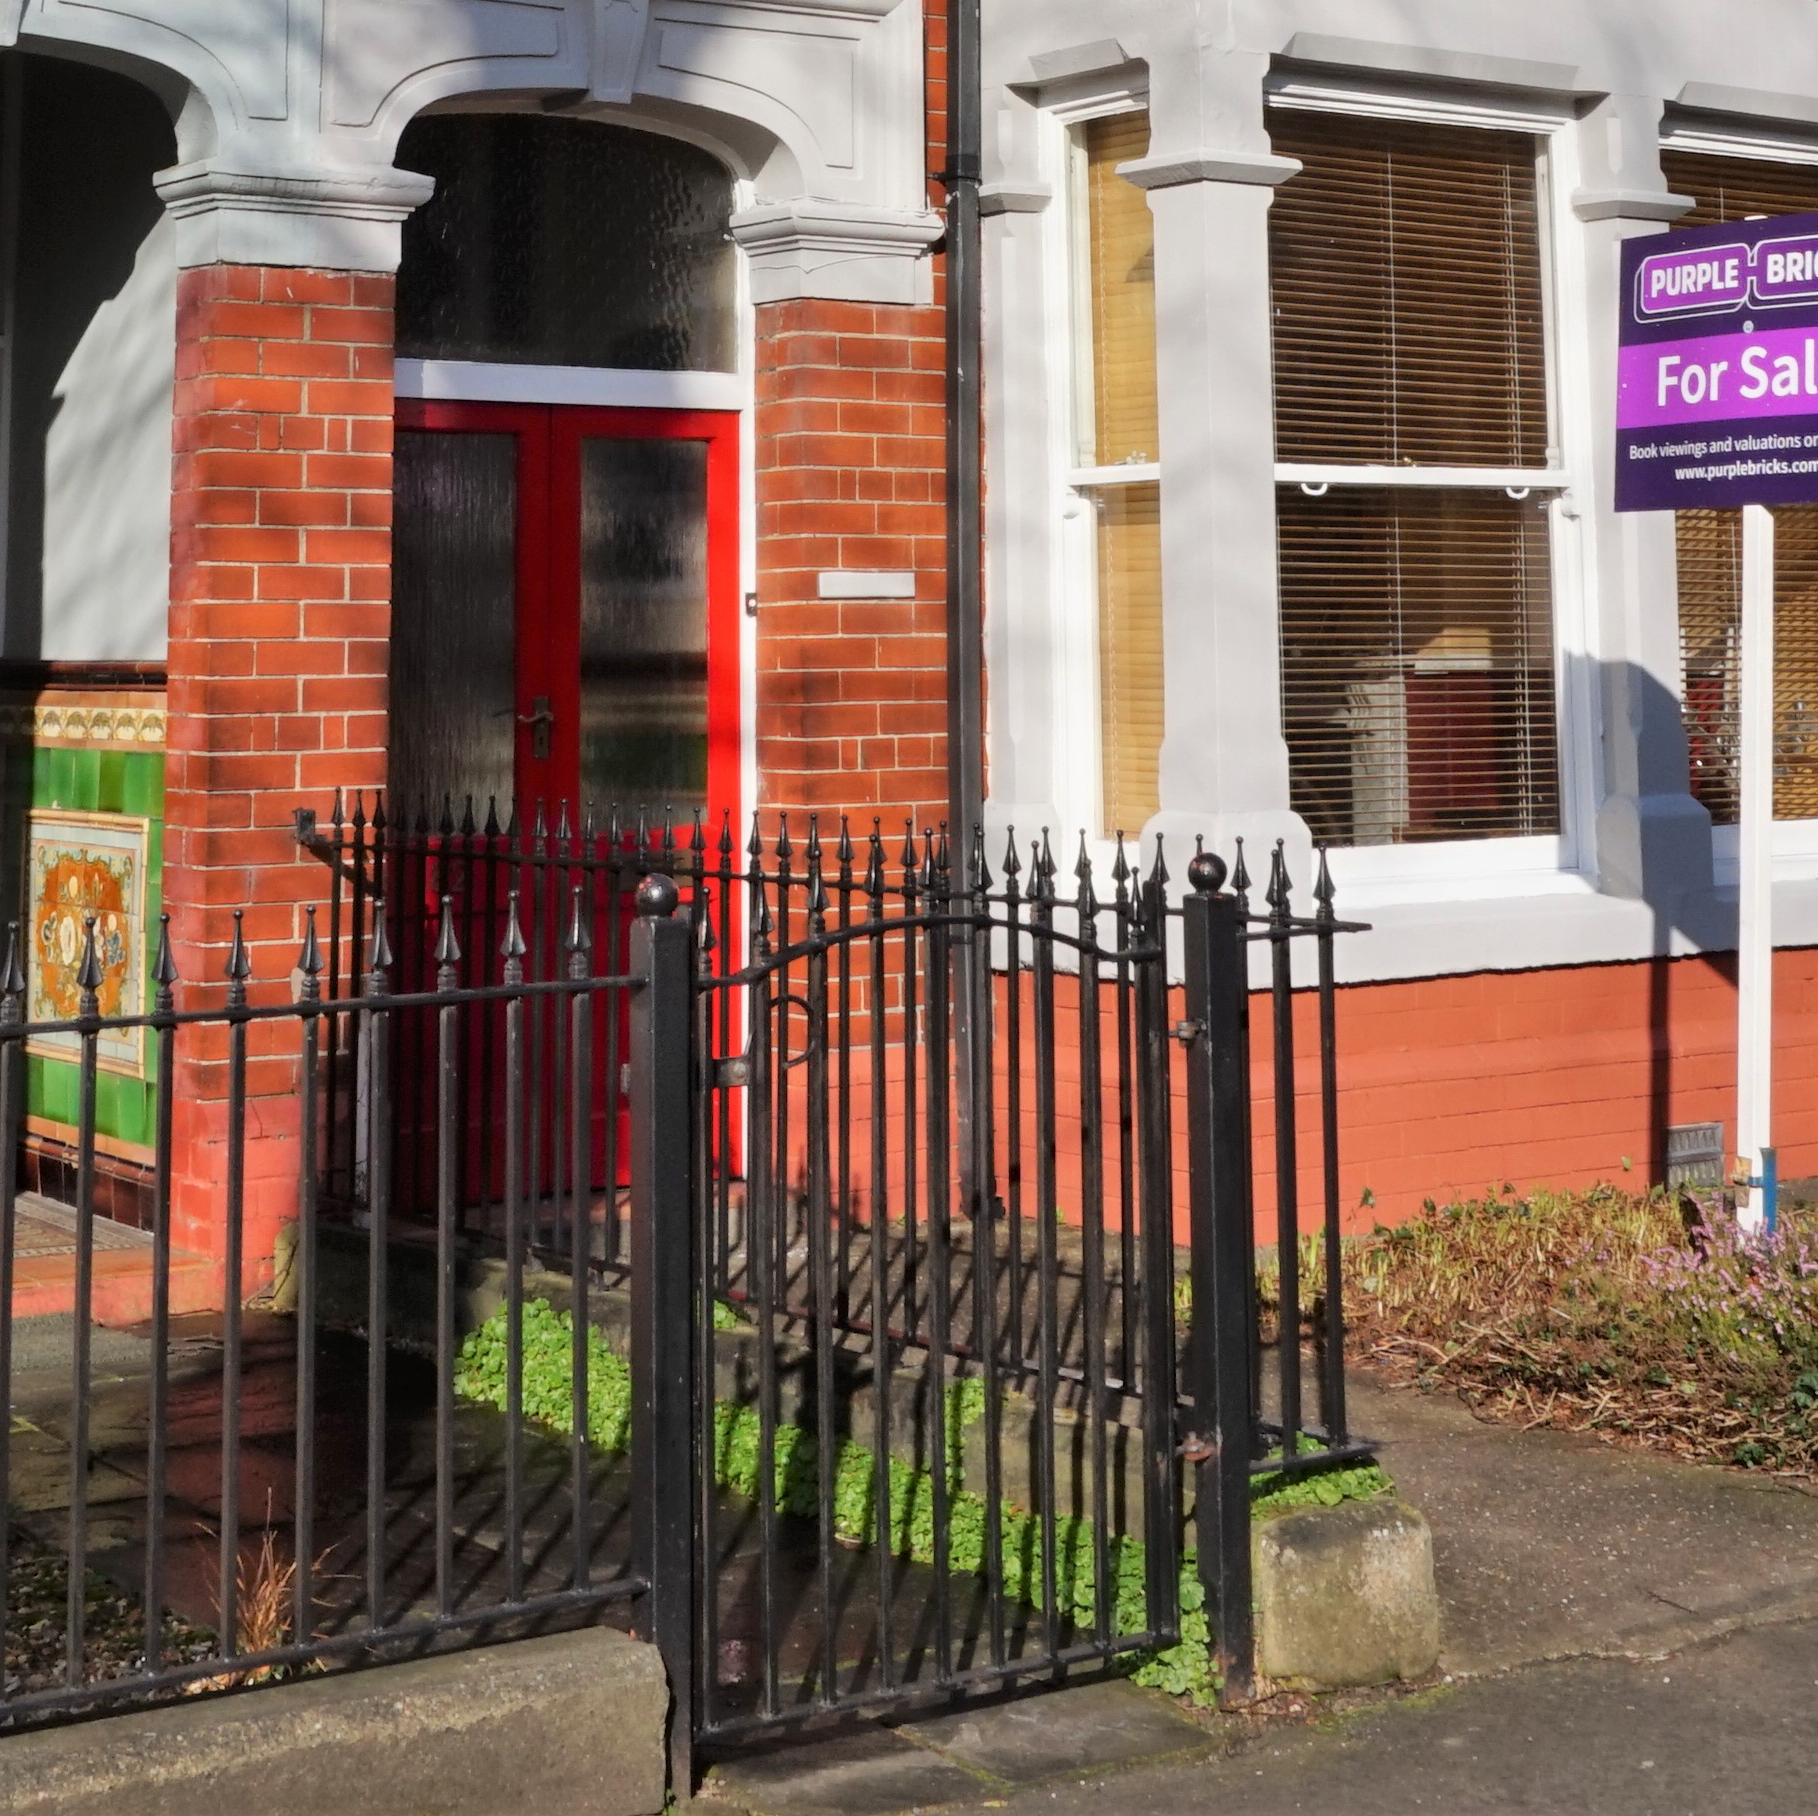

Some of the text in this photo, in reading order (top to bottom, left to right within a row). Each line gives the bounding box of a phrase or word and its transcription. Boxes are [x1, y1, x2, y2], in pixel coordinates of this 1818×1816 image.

[1650, 258, 1740, 299] PURPLE
[1657, 355, 1729, 407] For
[1629, 442, 1659, 460] Book
[1659, 440, 1708, 458] viewings
[1709, 435, 1732, 454] and
[1734, 433, 1801, 452] valuations
